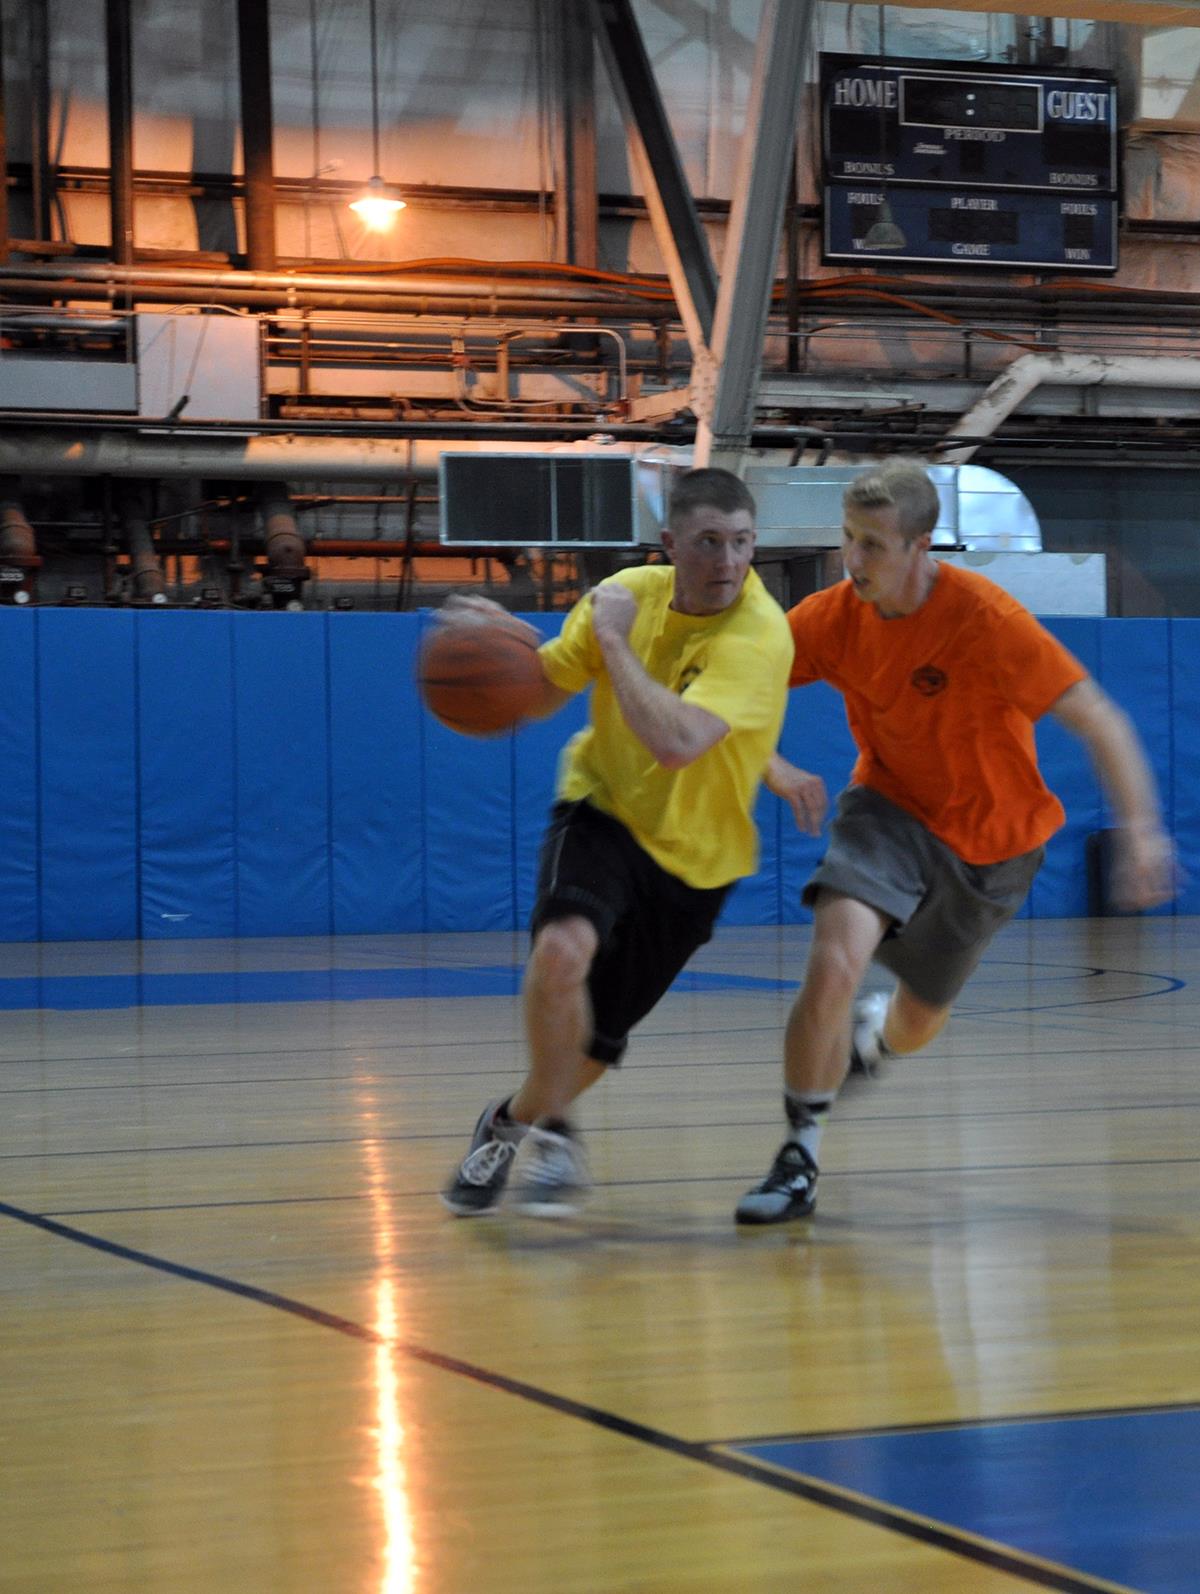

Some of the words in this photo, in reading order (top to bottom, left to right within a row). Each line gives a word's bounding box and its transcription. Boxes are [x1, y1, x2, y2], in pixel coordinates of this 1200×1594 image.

[834, 77, 898, 109] HOME
[1046, 90, 1109, 121] GUEST
[943, 128, 1007, 143] PERIOD
[843, 161, 896, 176] BONUS
[1048, 172, 1099, 187] BONUS
[950, 197, 999, 211] PLAYER
[1060, 203, 1098, 216] FOULS
[951, 242, 992, 256] GAME
[1064, 247, 1091, 261] WIN
